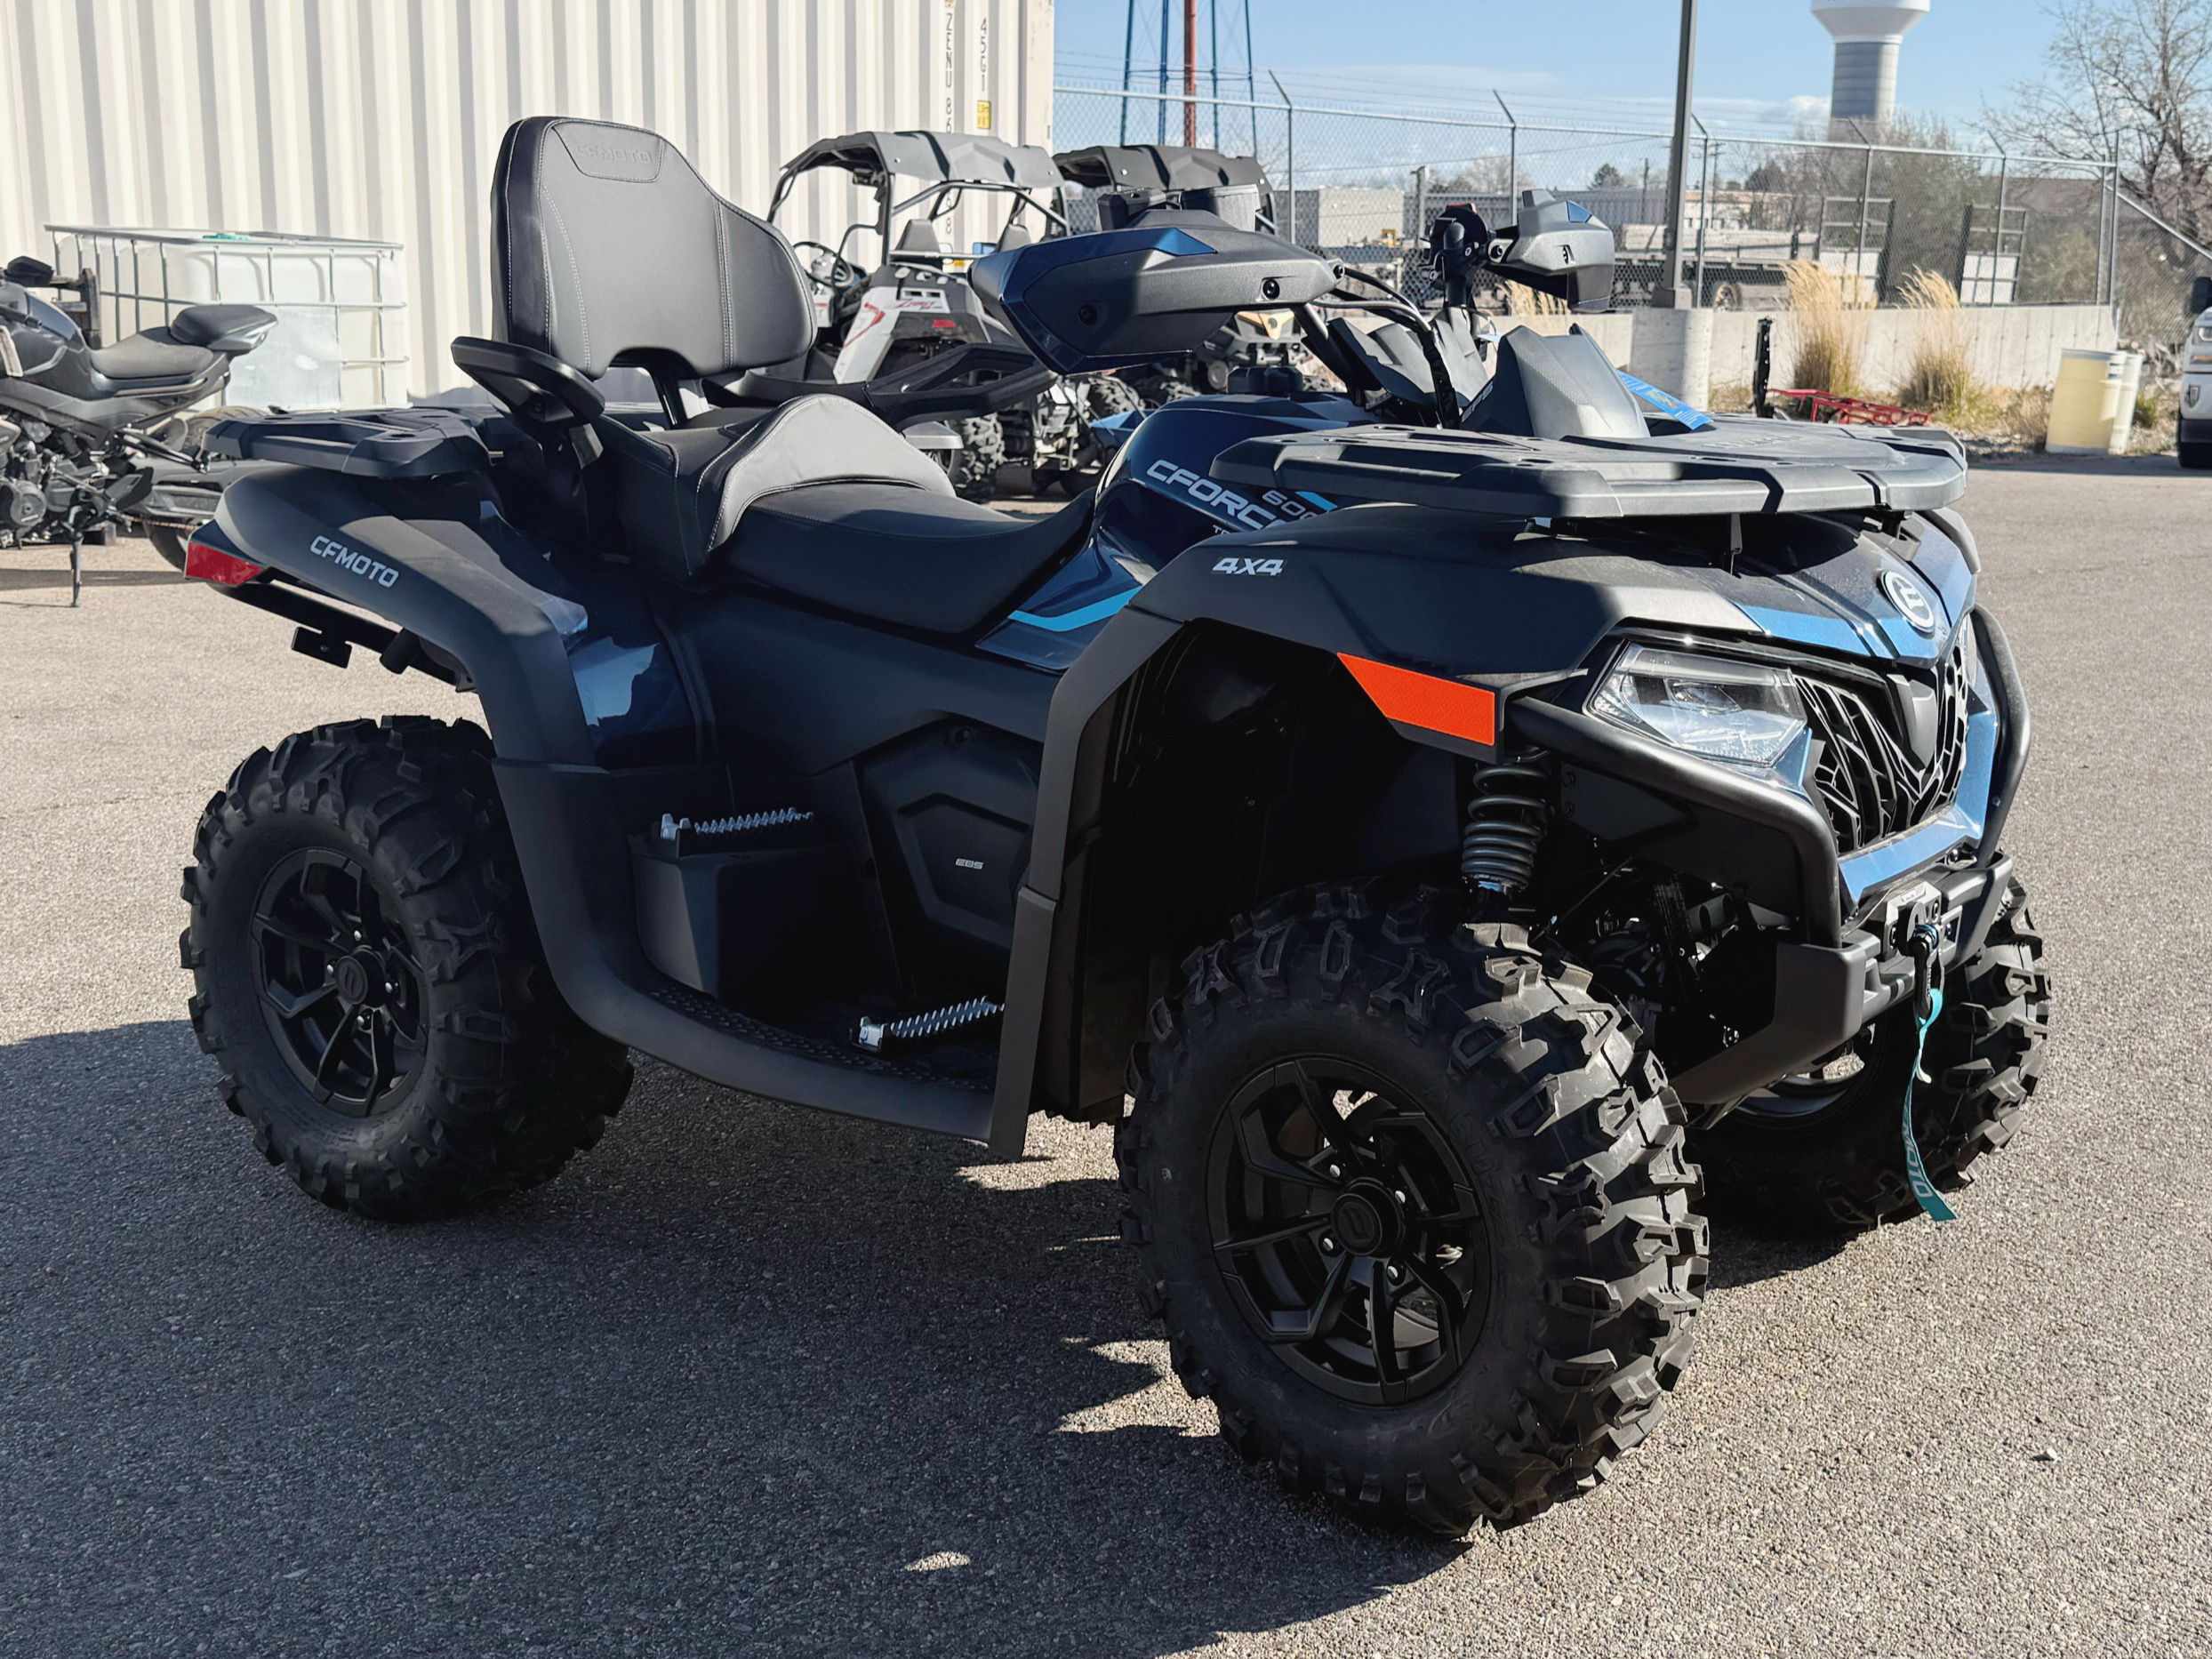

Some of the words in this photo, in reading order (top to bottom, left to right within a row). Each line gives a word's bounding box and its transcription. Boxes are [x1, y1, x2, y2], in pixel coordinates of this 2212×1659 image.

[1146, 459, 1286, 531] CFORC
[309, 535, 399, 588] CFMOTO
[955, 858, 983, 870] EBS
